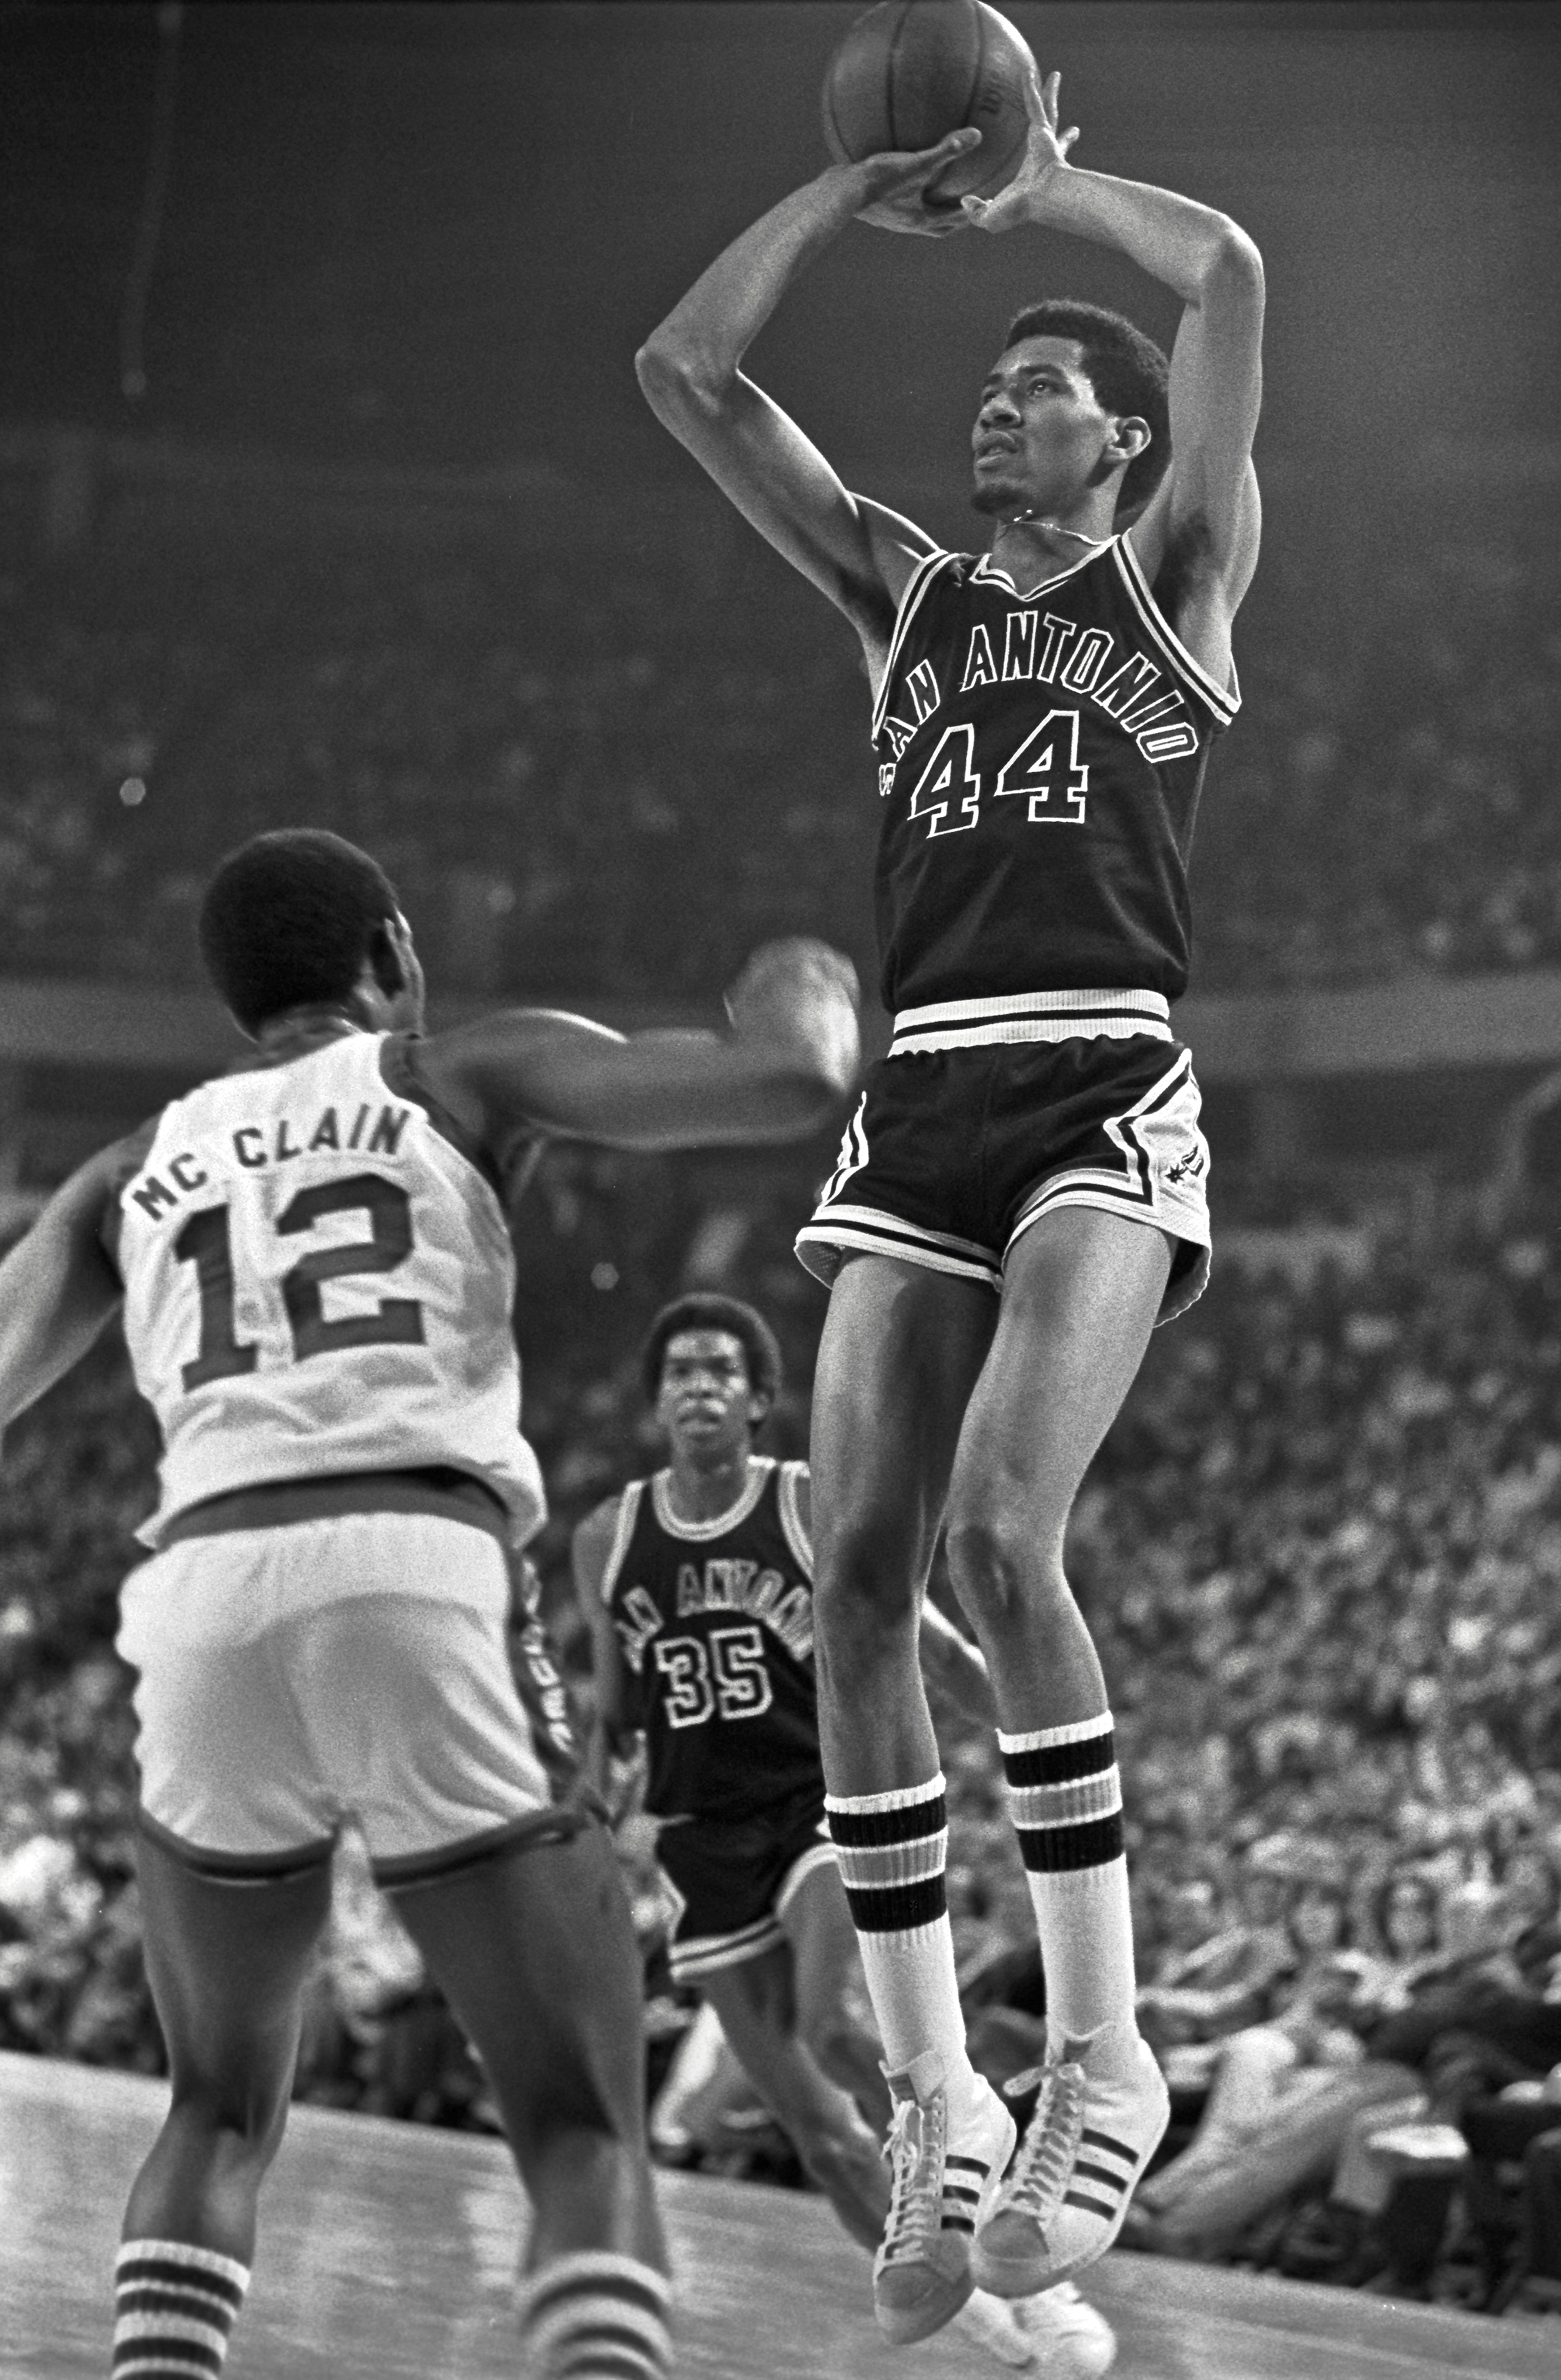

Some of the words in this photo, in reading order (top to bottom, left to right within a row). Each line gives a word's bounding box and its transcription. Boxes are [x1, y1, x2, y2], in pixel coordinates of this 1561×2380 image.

[878, 658, 940, 797] SAN
[960, 610, 1199, 764] ANTONIO
[906, 709, 1089, 839] 44
[132, 1152, 208, 1221] MC
[232, 1102, 410, 1169] CLAIN
[174, 1171, 427, 1395] 12
[614, 1586, 664, 1675] AN
[677, 1558, 814, 1662] ANTON
[653, 1626, 773, 1729] 35
